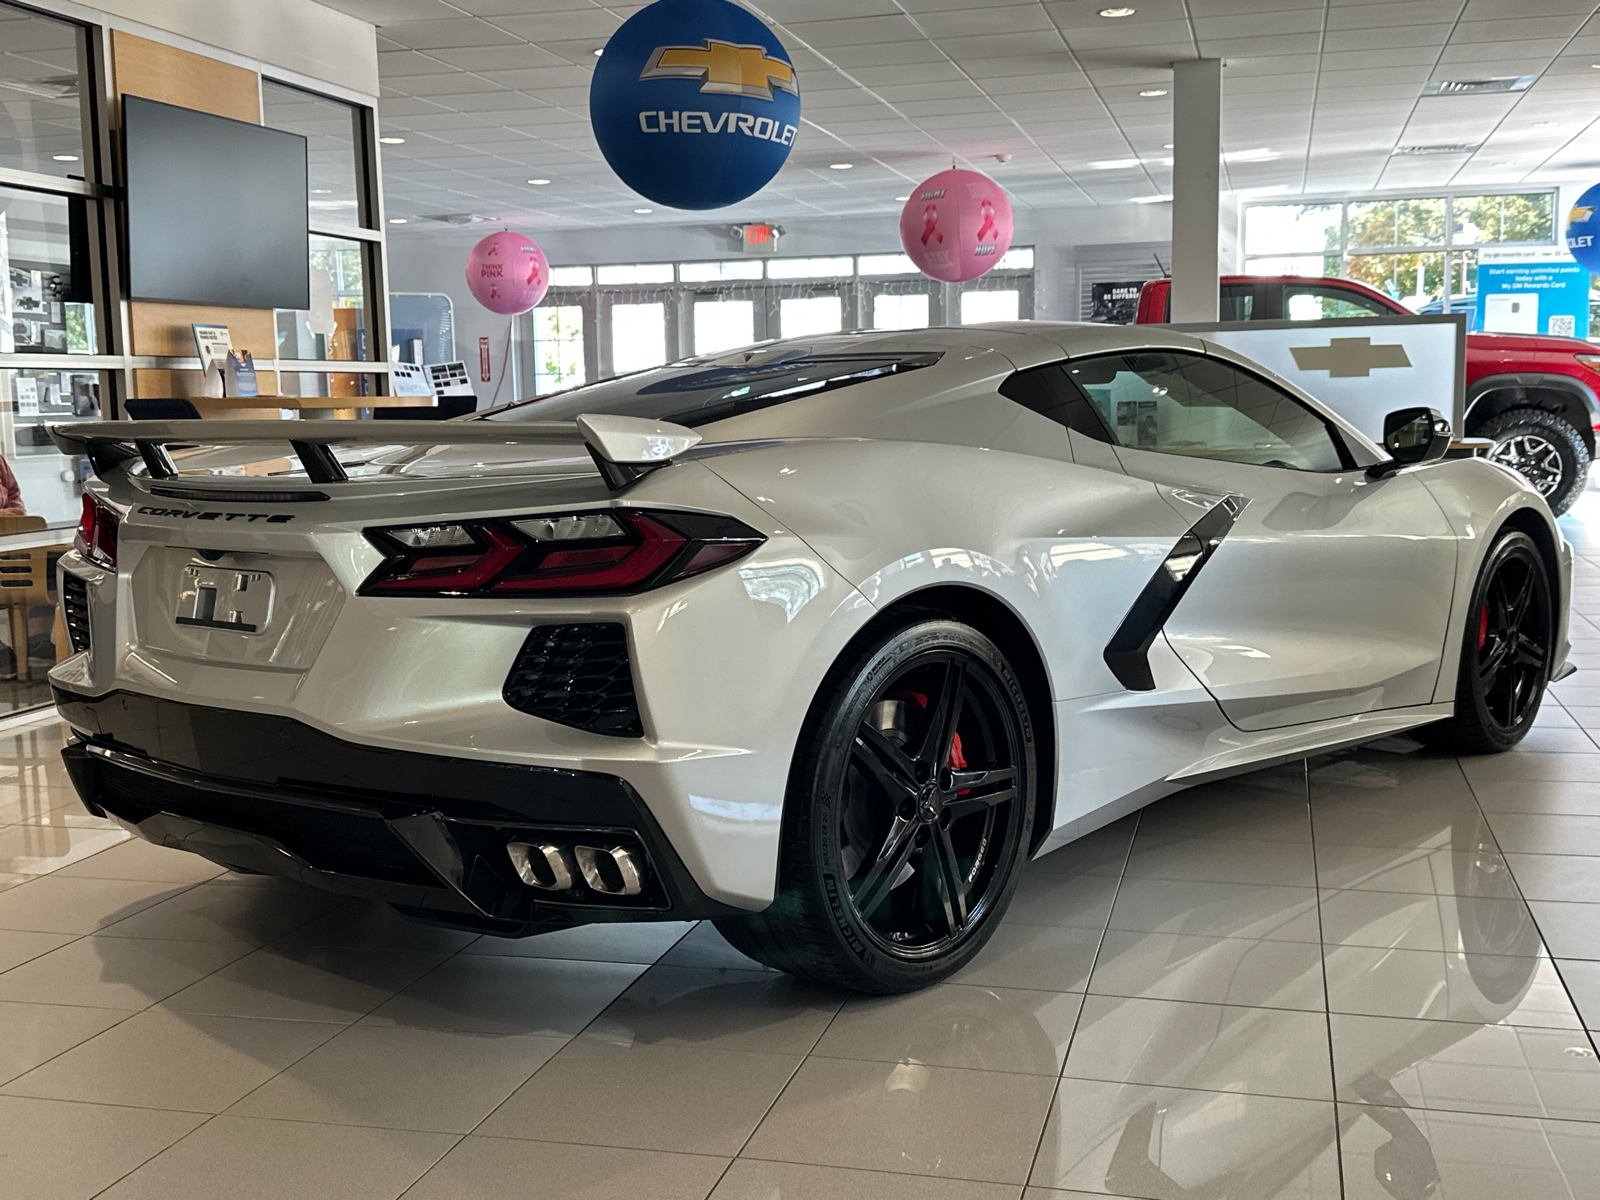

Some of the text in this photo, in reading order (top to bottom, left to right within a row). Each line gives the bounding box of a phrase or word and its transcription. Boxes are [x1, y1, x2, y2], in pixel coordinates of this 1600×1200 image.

[639, 111, 797, 147] CHEVROLET
[749, 225, 769, 243] EXIT
[974, 243, 996, 256] HOPE
[481, 270, 503, 278] PINK
[137, 506, 295, 523] CORVETTE
[1002, 668, 1032, 739] MICHELIN
[968, 838, 987, 883] FORGED
[825, 879, 863, 953] MICHELIN
